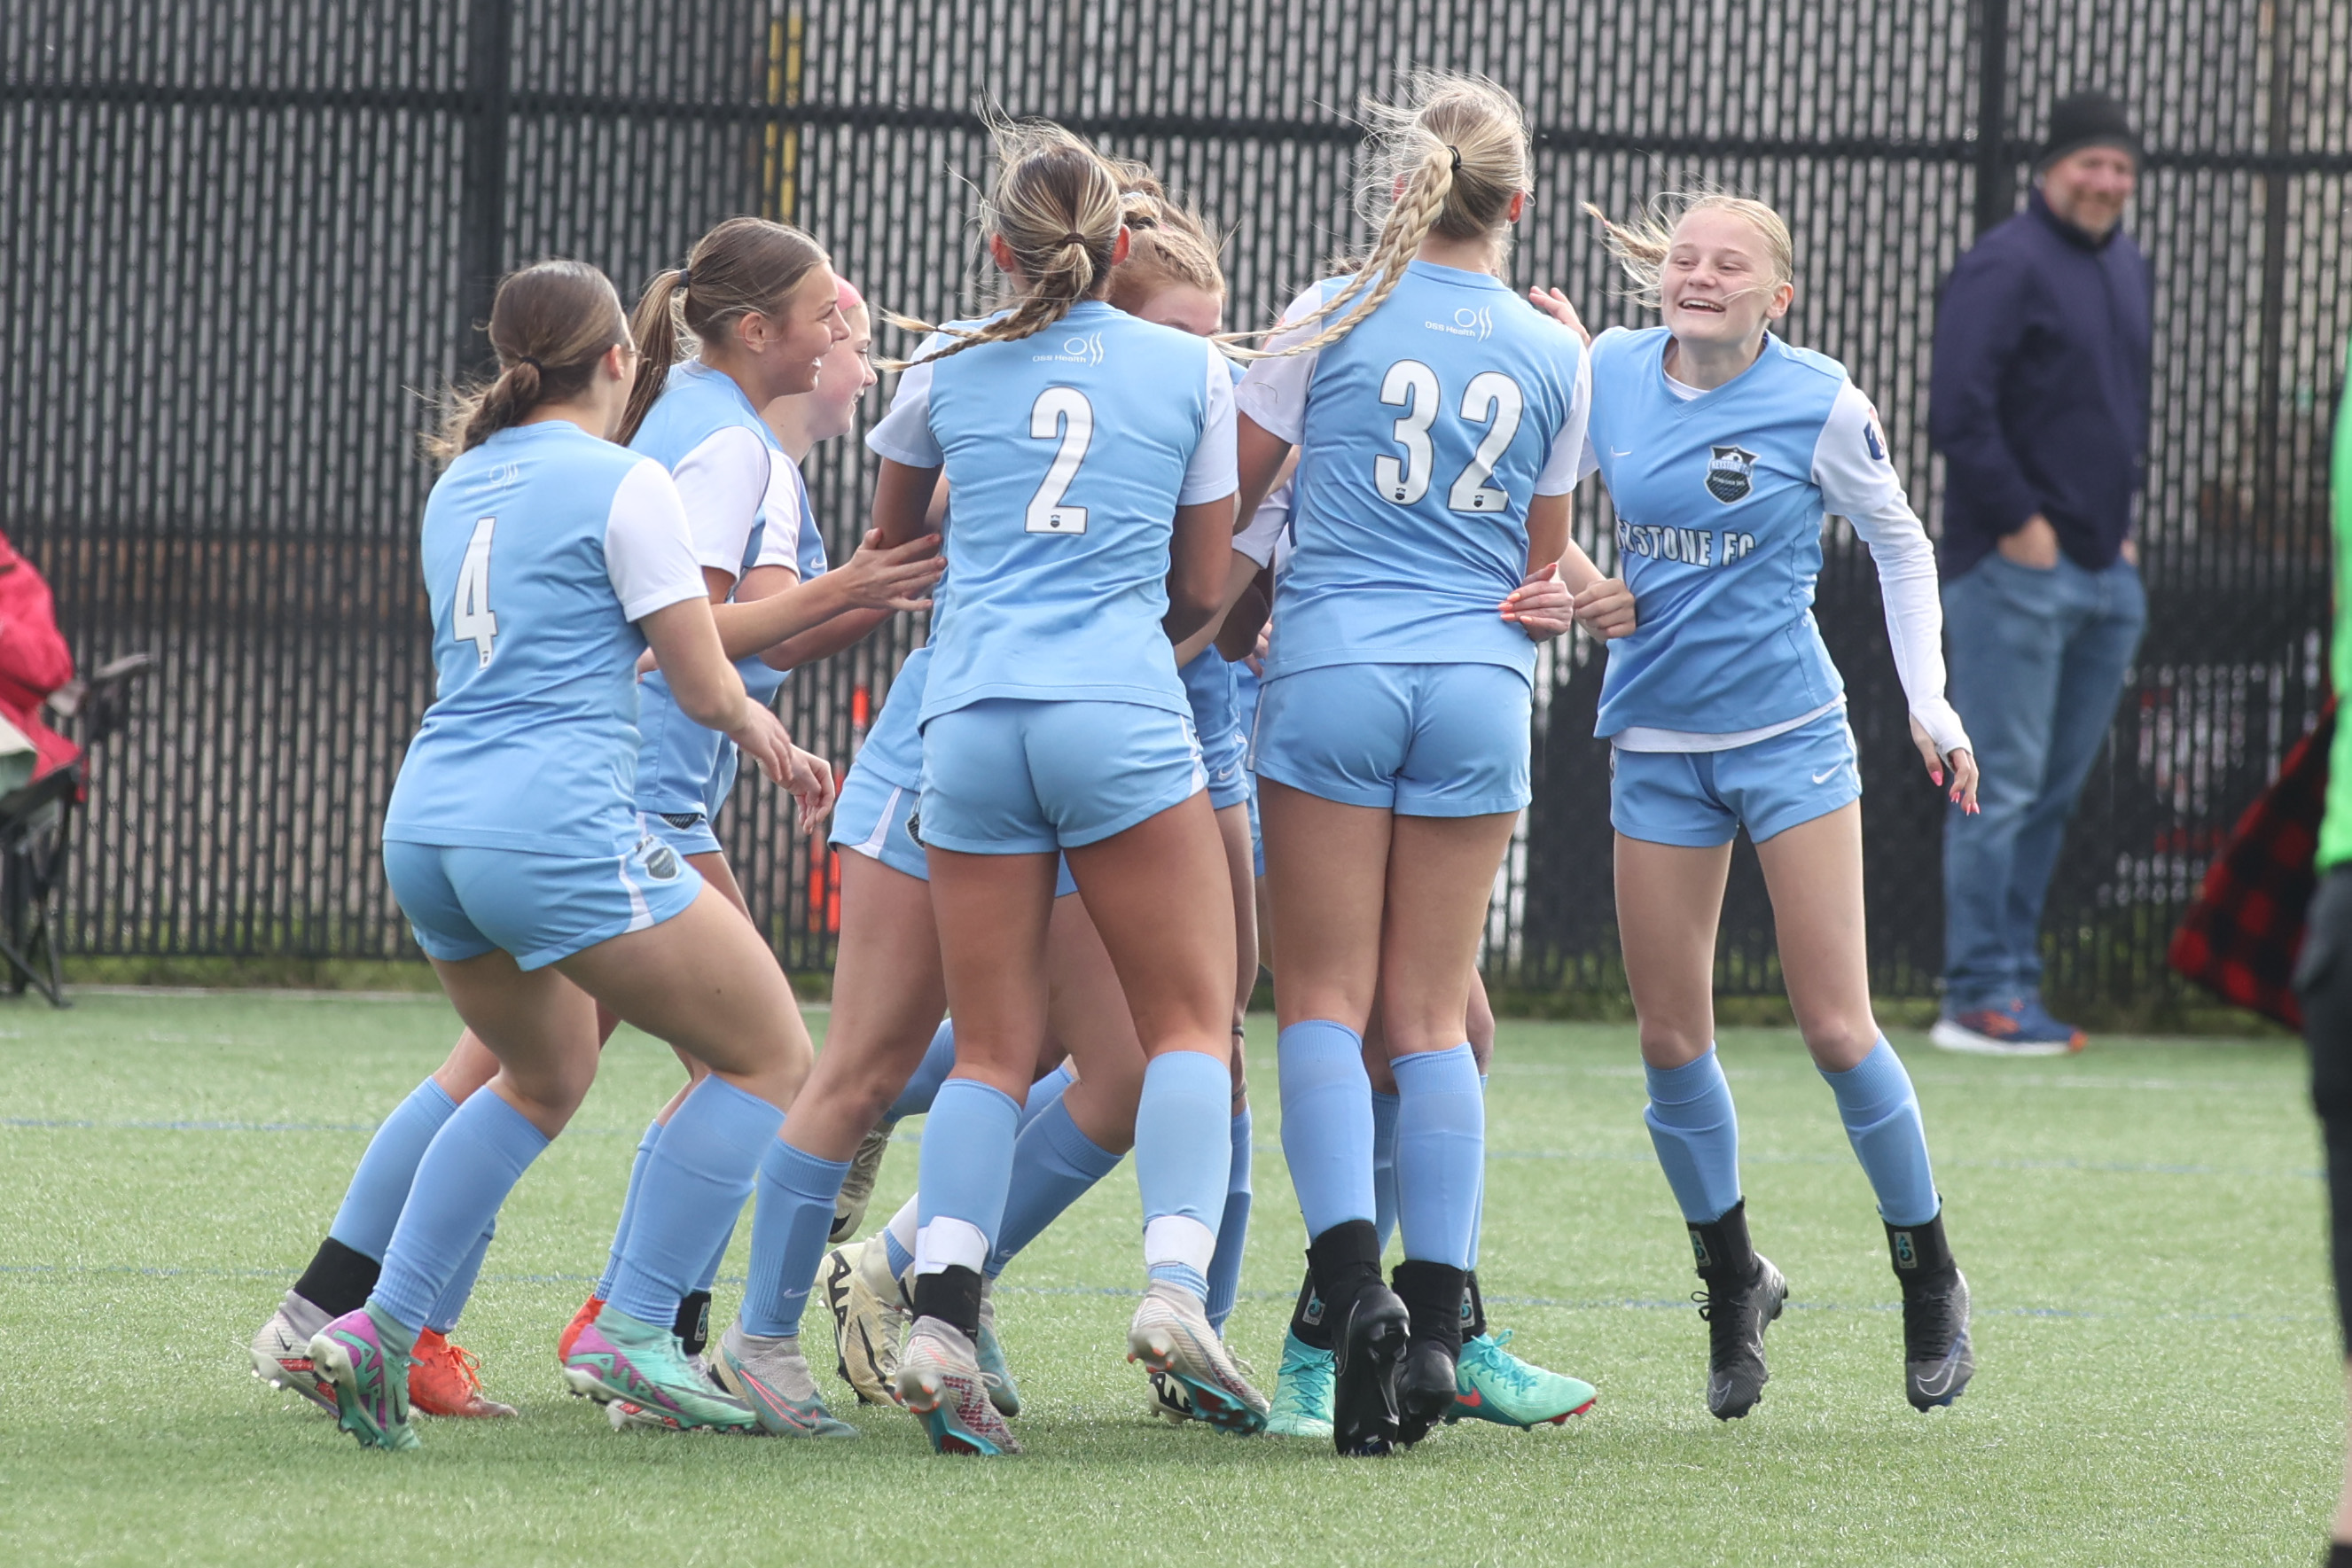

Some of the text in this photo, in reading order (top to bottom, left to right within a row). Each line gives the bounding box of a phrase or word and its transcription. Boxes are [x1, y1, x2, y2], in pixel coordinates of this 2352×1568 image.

[1054, 354, 1087, 363] Health
[1446, 325, 1476, 337] Health
[1024, 386, 1095, 535] 2
[1374, 358, 1524, 512] 32
[452, 516, 499, 672] 4
